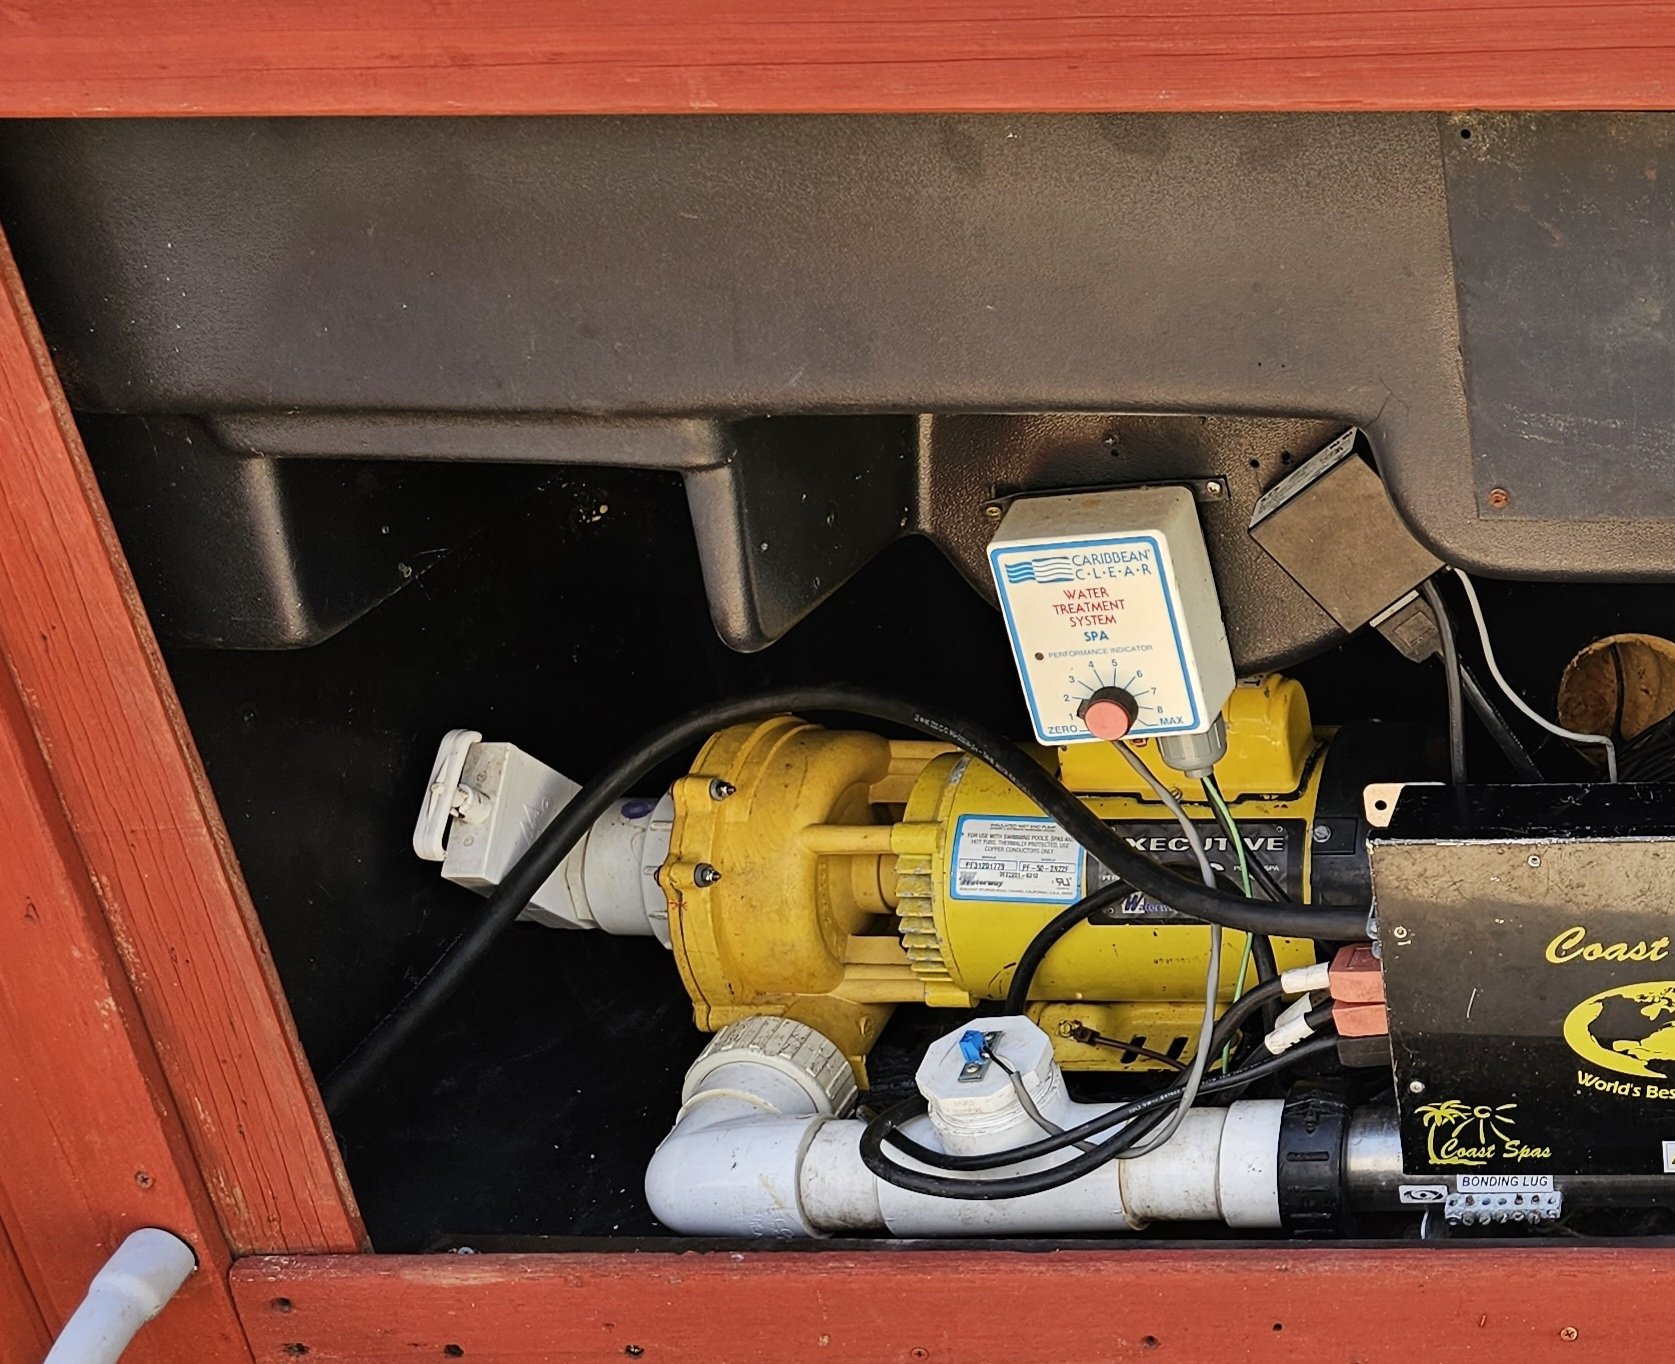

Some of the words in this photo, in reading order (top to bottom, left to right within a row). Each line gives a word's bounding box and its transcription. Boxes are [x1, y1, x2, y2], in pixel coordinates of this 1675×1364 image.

[1072, 551, 1149, 566] CARIBBEAN
[1064, 587, 1109, 600] WATER
[1052, 599, 1125, 615] TREATMENT
[1070, 615, 1117, 627] SYSTEM
[1084, 630, 1109, 642] SPA
[1048, 649, 1108, 658] PERFORMANCE
[1111, 645, 1153, 654] INDICATOR
[1137, 670, 1143, 678] 6
[1151, 687, 1156, 695] 7
[1158, 706, 1164, 714] 8
[1160, 716, 1184, 725] MAX
[1048, 725, 1077, 734] ZERO
[1126, 837, 1285, 851] XECUTVE
[1546, 926, 1670, 963] Coast
[1577, 1070, 1641, 1098] World's
[1441, 1138, 1495, 1158] Coast
[1503, 1140, 1552, 1163] Spas
[1463, 1176, 1519, 1187] BONDING
[1523, 1176, 1548, 1186] LUG
